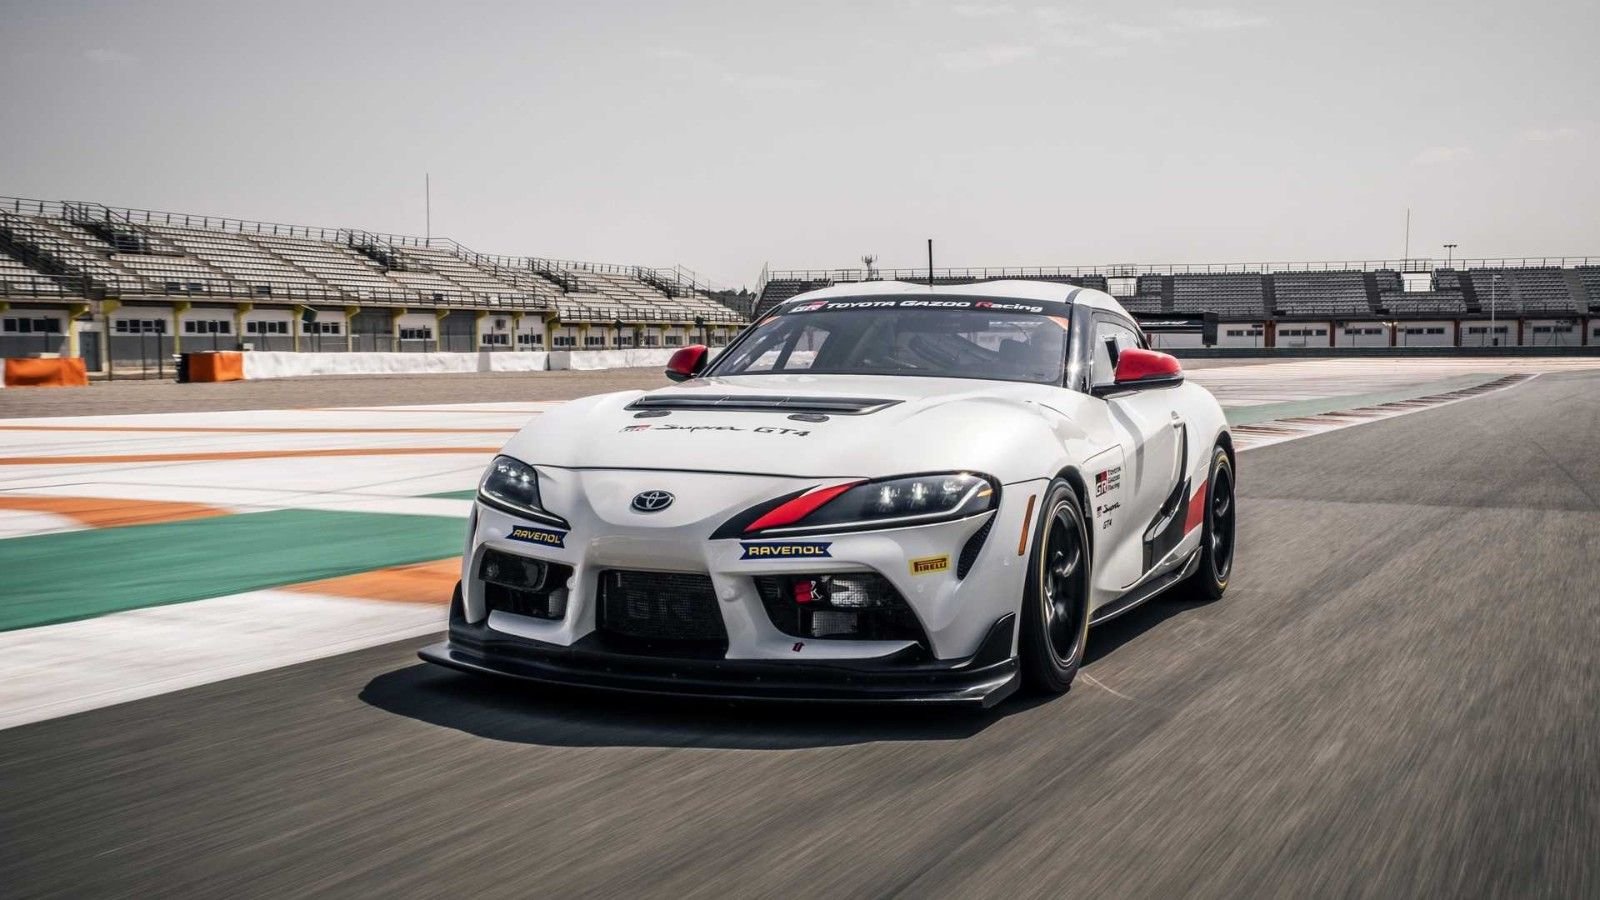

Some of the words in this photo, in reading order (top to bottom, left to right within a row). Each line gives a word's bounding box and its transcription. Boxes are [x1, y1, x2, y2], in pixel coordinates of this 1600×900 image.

[975, 301, 1043, 313] Racing
[753, 427, 811, 437] GT4
[513, 529, 561, 544] RAVENOL
[748, 546, 824, 556] RAVENOL
